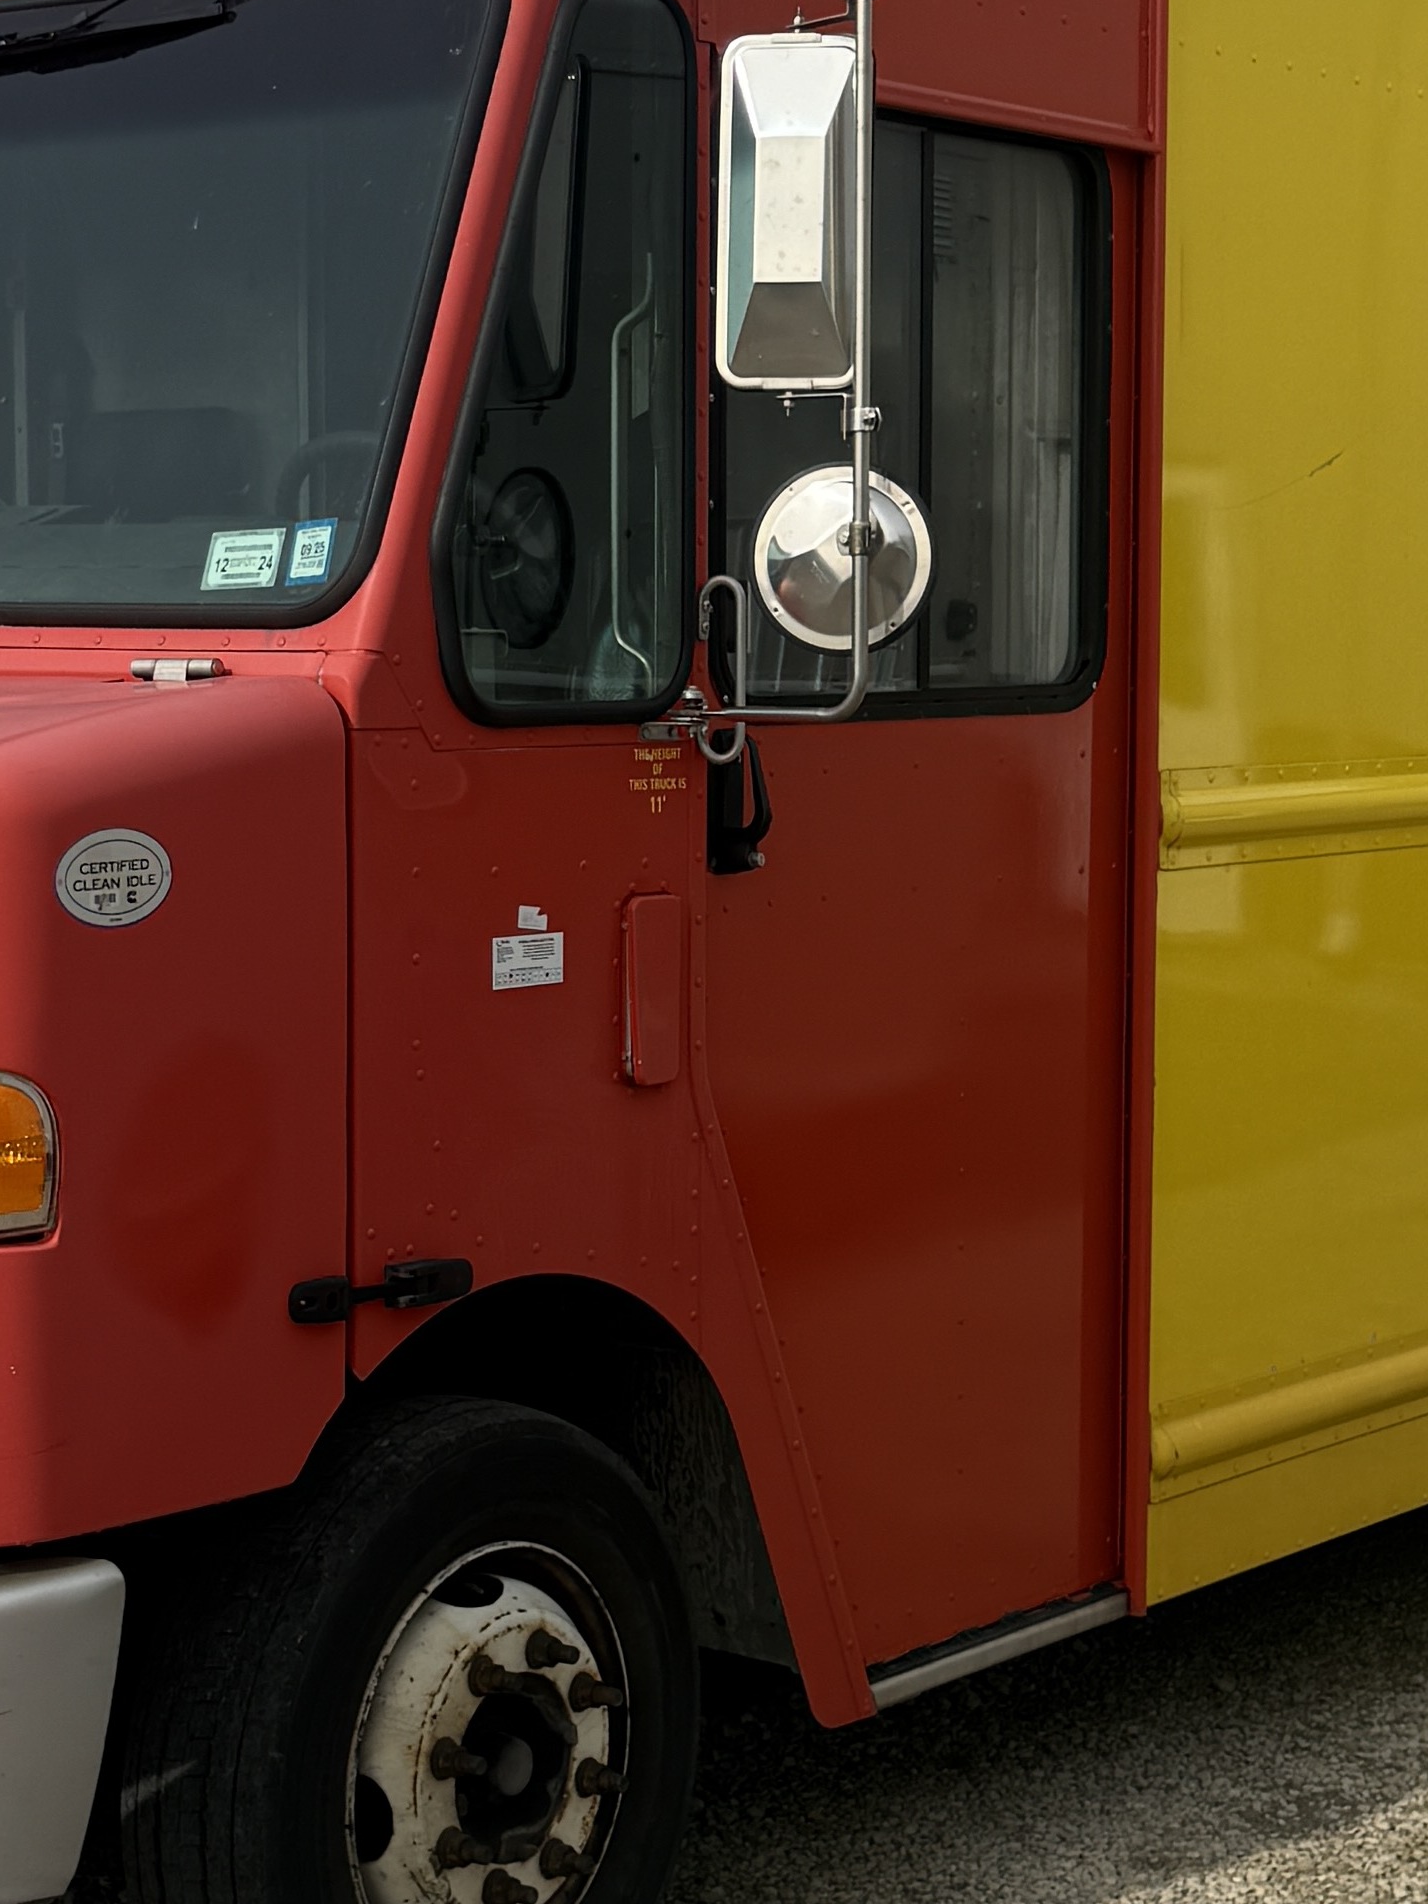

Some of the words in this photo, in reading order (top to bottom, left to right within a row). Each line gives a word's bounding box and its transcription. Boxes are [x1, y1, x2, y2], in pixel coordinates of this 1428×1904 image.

[215, 558, 229, 573] 12
[258, 555, 273, 571] 24
[652, 763, 663, 775] OF
[629, 778, 648, 791] THIS
[650, 777, 677, 790] TRUCK
[678, 777, 687, 789] IS
[79, 858, 150, 875] CERTIFIED
[73, 877, 121, 892] CLEAN
[126, 874, 157, 888] IDLE
